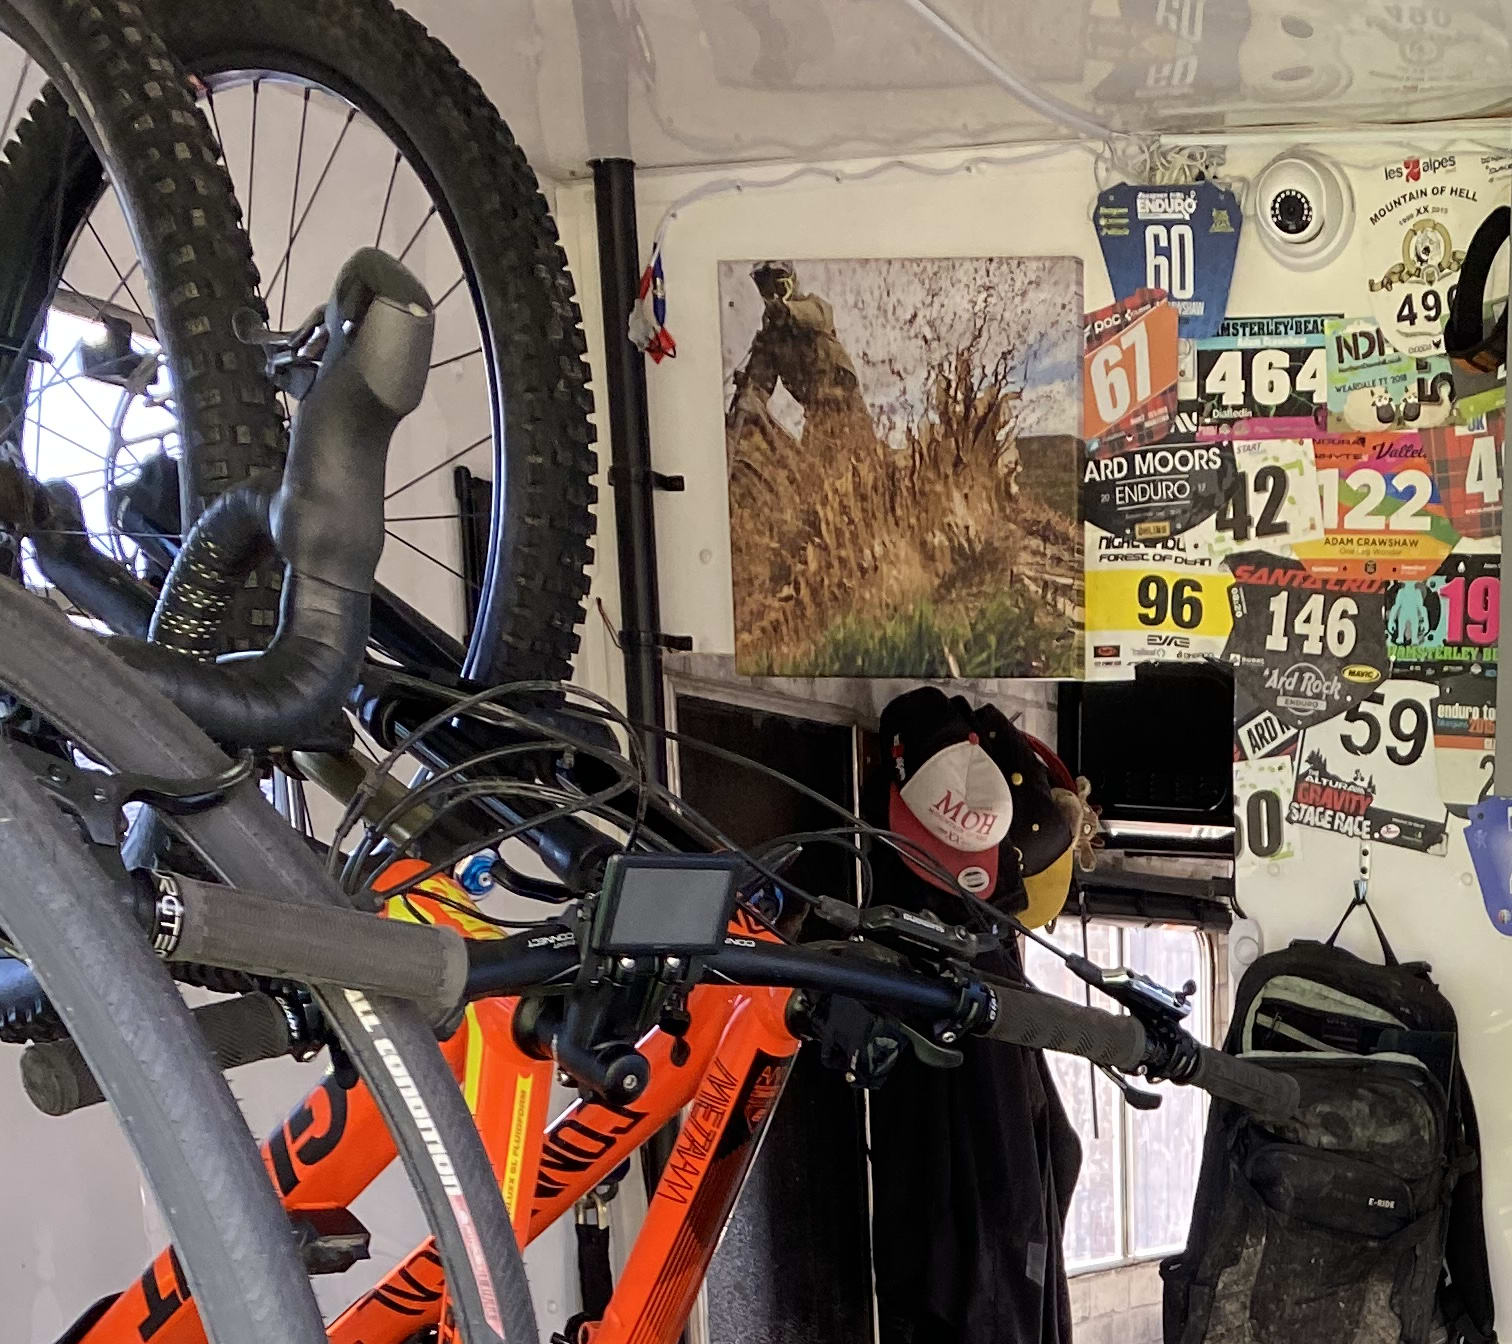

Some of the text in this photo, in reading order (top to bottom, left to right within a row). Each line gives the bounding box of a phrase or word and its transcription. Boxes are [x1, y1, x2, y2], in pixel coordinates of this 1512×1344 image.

[1422, 155, 1456, 174] alpes
[1370, 186, 1478, 226] MOUNTAIN OF HELL
[1145, 224, 1194, 300] 60
[1090, 320, 1151, 424] 67
[1205, 348, 1327, 405] 464
[1135, 447, 1222, 476] MOORS
[1115, 479, 1191, 505] ENDURO
[1216, 465, 1289, 541] 42
[1317, 468, 1432, 530] 122
[1324, 537, 1419, 548] ADAM CRAWSHAW
[1138, 574, 1203, 630] 96
[1265, 590, 1359, 658] 146
[1301, 672, 1342, 701] Rock
[1340, 692, 1428, 766] 59
[1437, 702, 1479, 719] enduro
[934, 790, 998, 836] MOH
[1290, 802, 1372, 840] STAGE RACE
